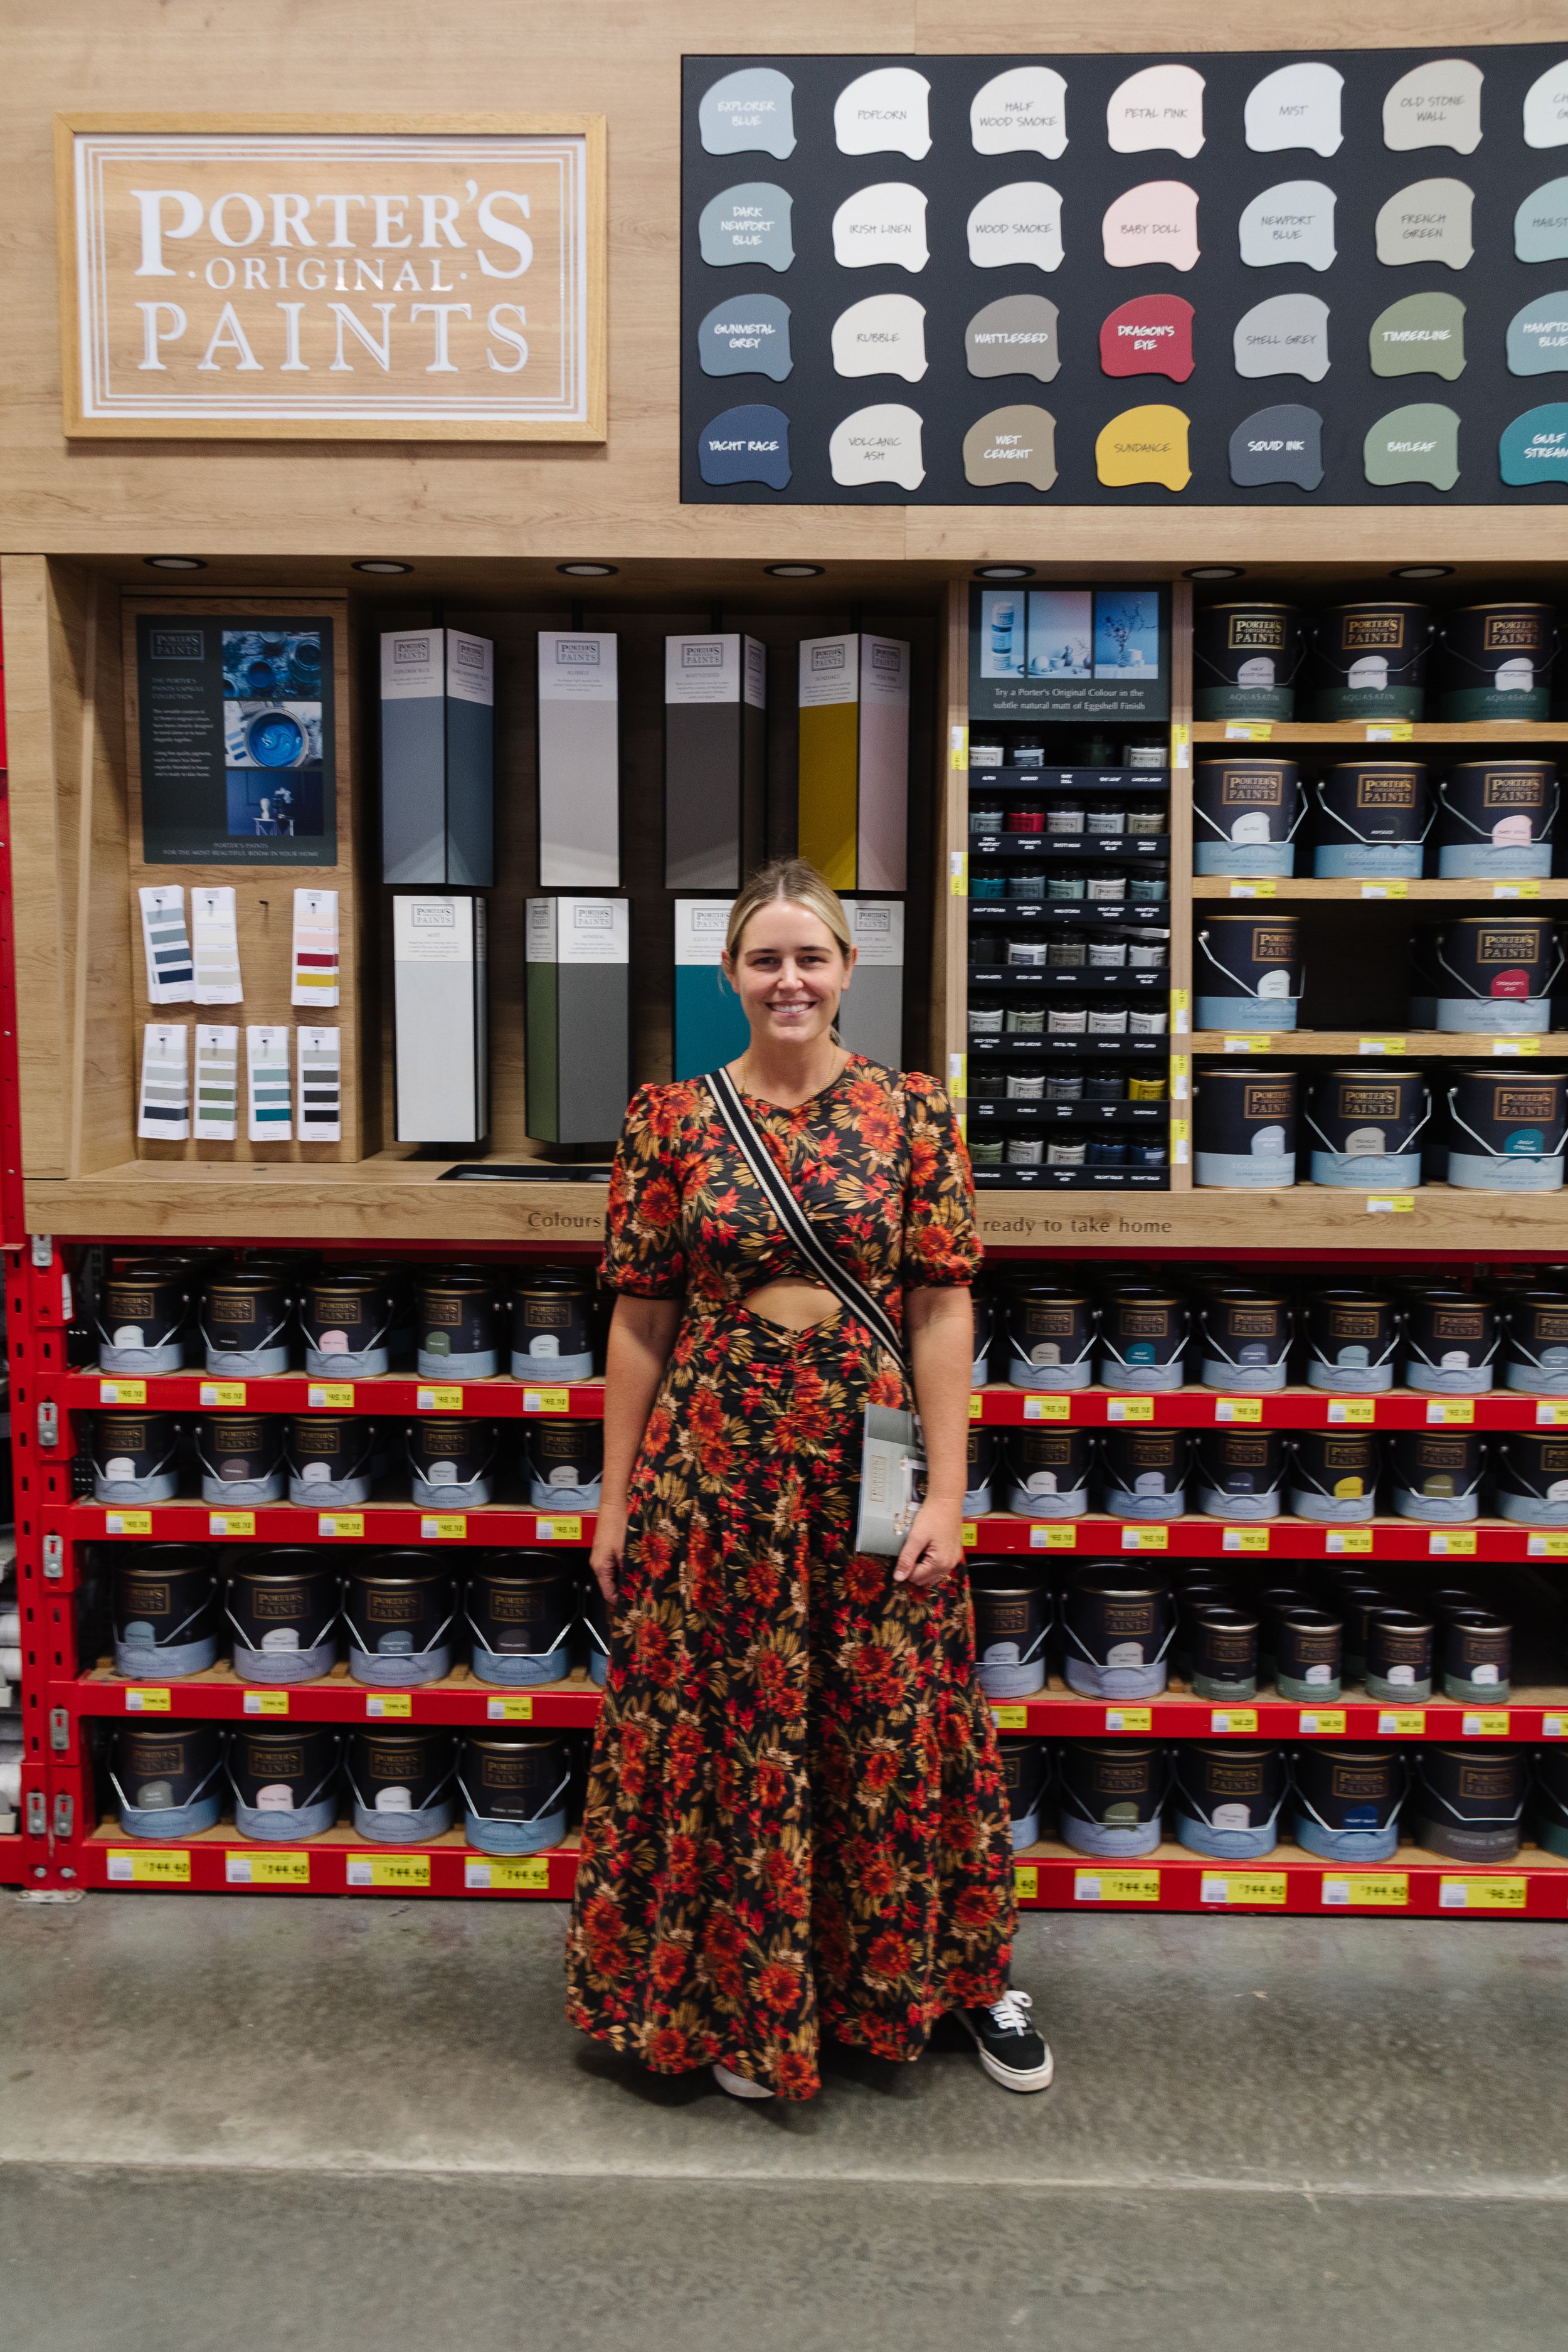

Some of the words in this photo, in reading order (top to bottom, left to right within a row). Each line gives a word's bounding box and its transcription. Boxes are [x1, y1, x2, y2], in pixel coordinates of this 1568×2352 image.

[1401, 98, 1424, 107] OLD
[1428, 95, 1465, 106] STONE
[718, 101, 776, 112] EXPLORER
[1005, 101, 1034, 112] HALF
[1279, 105, 1309, 115] MIST
[858, 110, 907, 120] POPCORN
[1125, 109, 1159, 118] PETAL
[1164, 109, 1188, 118] PINK
[1417, 112, 1447, 121] WALL
[732, 116, 763, 126] BLUE
[980, 117, 1013, 126] WOOD
[1017, 116, 1057, 127] SMOKE
[733, 206, 763, 217] DARK
[1261, 215, 1316, 226] NEWPORT
[1401, 213, 1446, 224] FRENCH
[130, 179, 534, 280] PORTER'S
[721, 221, 775, 231] NEWPORT
[849, 225, 877, 234] IRISH
[881, 225, 911, 233] LINEN
[975, 225, 1008, 233] WOOD
[1012, 223, 1053, 234] SMOKE
[1121, 225, 1148, 235] BABY
[1152, 225, 1180, 234] DOLL
[1273, 230, 1303, 240] BLUE
[1402, 228, 1443, 239] GREEN
[733, 235, 763, 245] BLUE
[204, 257, 453, 292] ORIGINAL
[714, 324, 775, 334] GUNMETAL
[1118, 326, 1175, 337] DRAGON'S
[134, 301, 529, 374] PAINTS
[857, 333, 900, 342] RUBBLE
[974, 333, 1048, 344] WATTLESEED
[1246, 335, 1281, 346] SHELL
[1285, 335, 1317, 345] GREY
[1382, 330, 1451, 342] TIMBERLINE
[729, 338, 761, 348] GREY
[1134, 339, 1158, 350] EYE
[849, 437, 902, 446] VOLCANIC
[995, 435, 1022, 445] WET
[1532, 433, 1567, 445] GULF
[709, 440, 746, 451] YACHT
[748, 441, 780, 451] RACE
[1114, 443, 1171, 452] SUNDANCE
[1248, 441, 1284, 452] SQUID
[1286, 441, 1305, 450] INK
[1387, 441, 1437, 452] BAYLEAF
[863, 452, 886, 460] ASH
[983, 449, 1033, 458] CEMENT
[1348, 618, 1398, 633] PORTER'S
[1235, 633, 1281, 643] PAINTS
[1348, 633, 1397, 643] PAINTS
[995, 688, 1010, 698] Try
[1052, 688, 1086, 698] Original
[1088, 689, 1117, 697] Colour
[1130, 689, 1144, 697] the
[993, 701, 1019, 709] subtle
[1084, 702, 1118, 712] Eggshell
[1229, 776, 1278, 789] PORTER'S
[1365, 779, 1412, 792] PORTER'S
[1229, 790, 1277, 799] PAINTS
[1364, 792, 1411, 802] PAINTS
[1490, 792, 1539, 802] PAINTS
[1485, 948, 1535, 957] PAINTS
[1344, 1104, 1394, 1113] PAINTS
[1501, 1105, 1550, 1115] PAINTS
[527, 1211, 602, 1227] Colours
[983, 1217, 1036, 1236] ready
[1044, 1219, 1063, 1232] to
[1071, 1217, 1110, 1232] take
[1119, 1217, 1173, 1233] home
